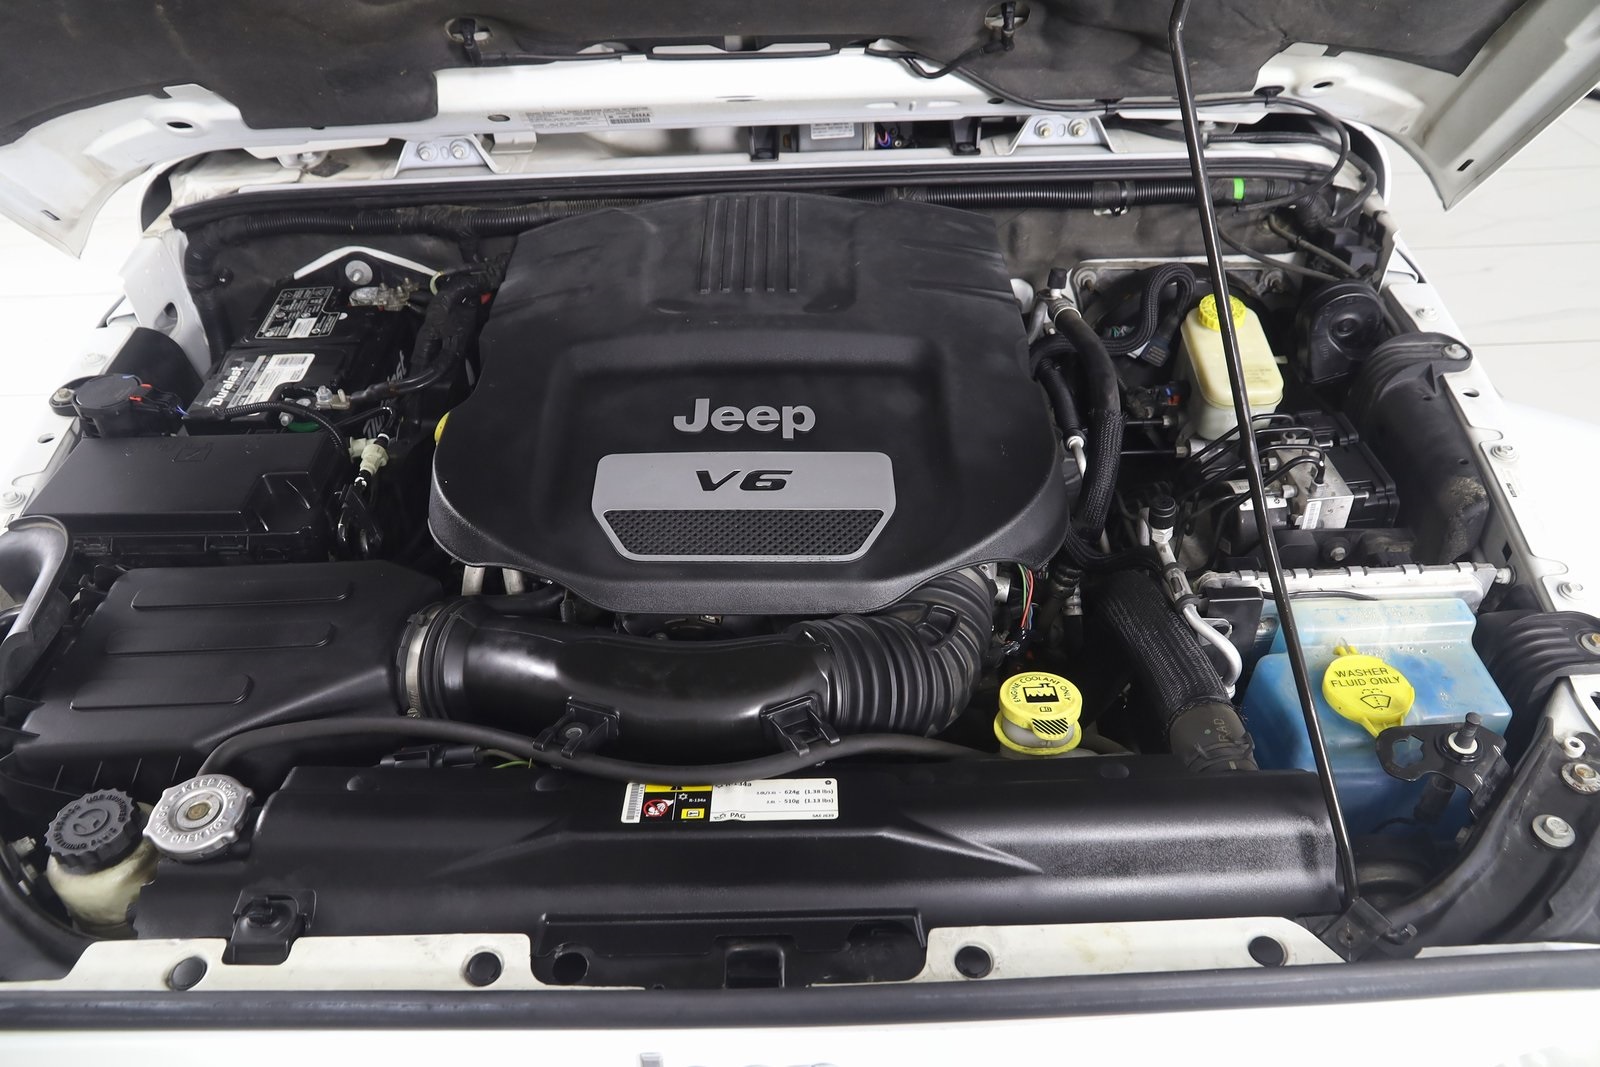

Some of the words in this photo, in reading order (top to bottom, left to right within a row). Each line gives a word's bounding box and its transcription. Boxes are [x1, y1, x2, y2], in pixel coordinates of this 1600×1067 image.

[204, 366, 244, 407] Duralast
[673, 398, 816, 439] Jeep
[695, 470, 793, 491] V6
[1331, 679, 1366, 687] FLUID
[1370, 676, 1401, 685] ONLY
[1334, 668, 1388, 677] WASHER
[1011, 683, 1021, 702] ENGINE
[1020, 676, 1061, 686] COOLANT
[1060, 685, 1072, 701] ONLY
[182, 777, 216, 793] KEEP
[730, 812, 746, 820] PAG
[170, 832, 206, 844] OPEN
[205, 817, 227, 836] HOT
